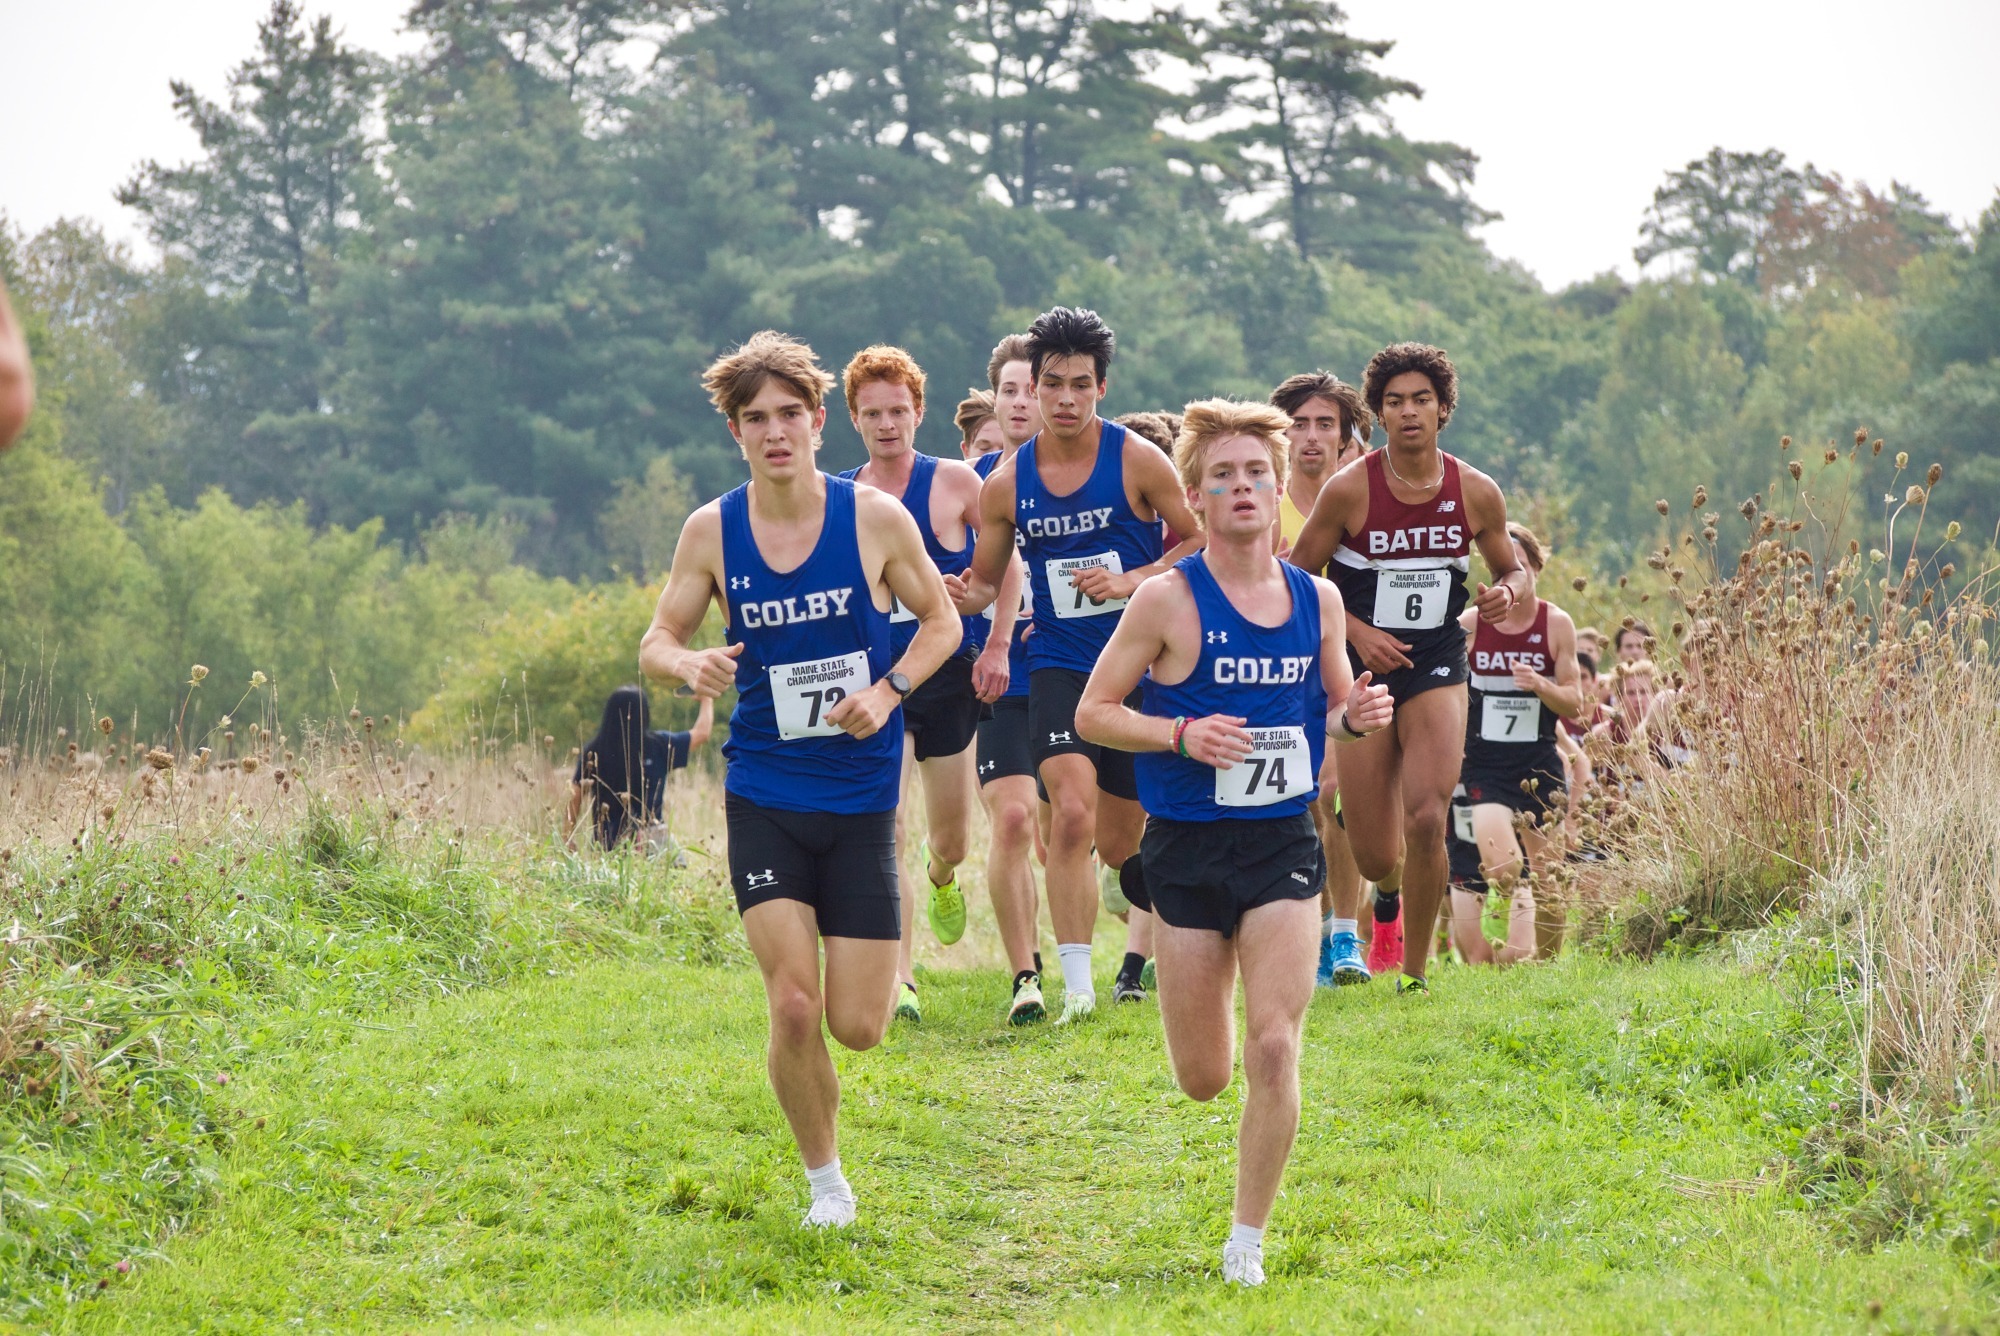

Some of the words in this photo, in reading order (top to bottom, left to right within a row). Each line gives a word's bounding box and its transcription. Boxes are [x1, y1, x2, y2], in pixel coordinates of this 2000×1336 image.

[1027, 507, 1113, 538] COLBY
[1369, 525, 1463, 554] BATES
[1061, 561, 1081, 569] MAINE
[1082, 558, 1102, 568] STATE
[1389, 580, 1441, 588] CHAMPIONSHIPS
[1417, 573, 1436, 581] STATE
[1068, 581, 1106, 609] 7
[740, 587, 853, 628] COLBY
[1405, 594, 1423, 621] 6
[792, 665, 818, 676] MAINE
[820, 659, 847, 672] STATE
[1214, 656, 1313, 684] COLBY
[1475, 651, 1545, 671] BATES
[786, 667, 855, 687] CHAMPIONSHIPS
[1504, 714, 1518, 735] 7
[1248, 731, 1267, 741] AINE
[1269, 730, 1291, 740] STATE
[1244, 757, 1288, 795] 74
